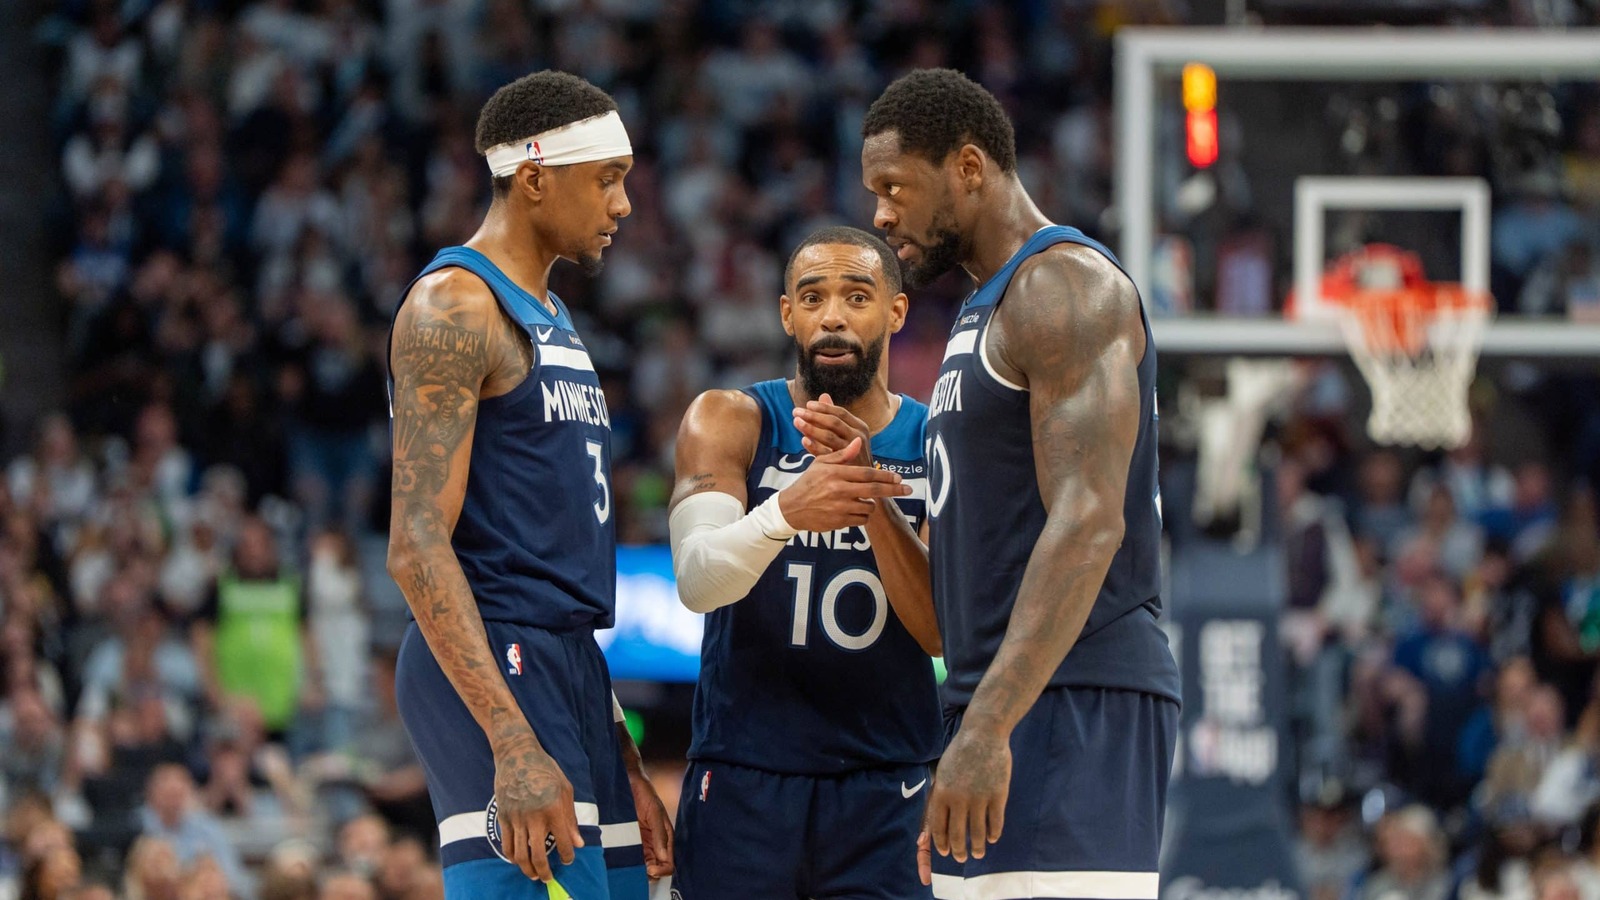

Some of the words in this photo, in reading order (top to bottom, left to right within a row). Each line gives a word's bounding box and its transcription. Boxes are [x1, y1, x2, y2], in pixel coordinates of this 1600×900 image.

[455, 331, 481, 357] WAY
[585, 441, 610, 525] 3
[881, 463, 923, 474] sezzle
[786, 562, 888, 651] 10
